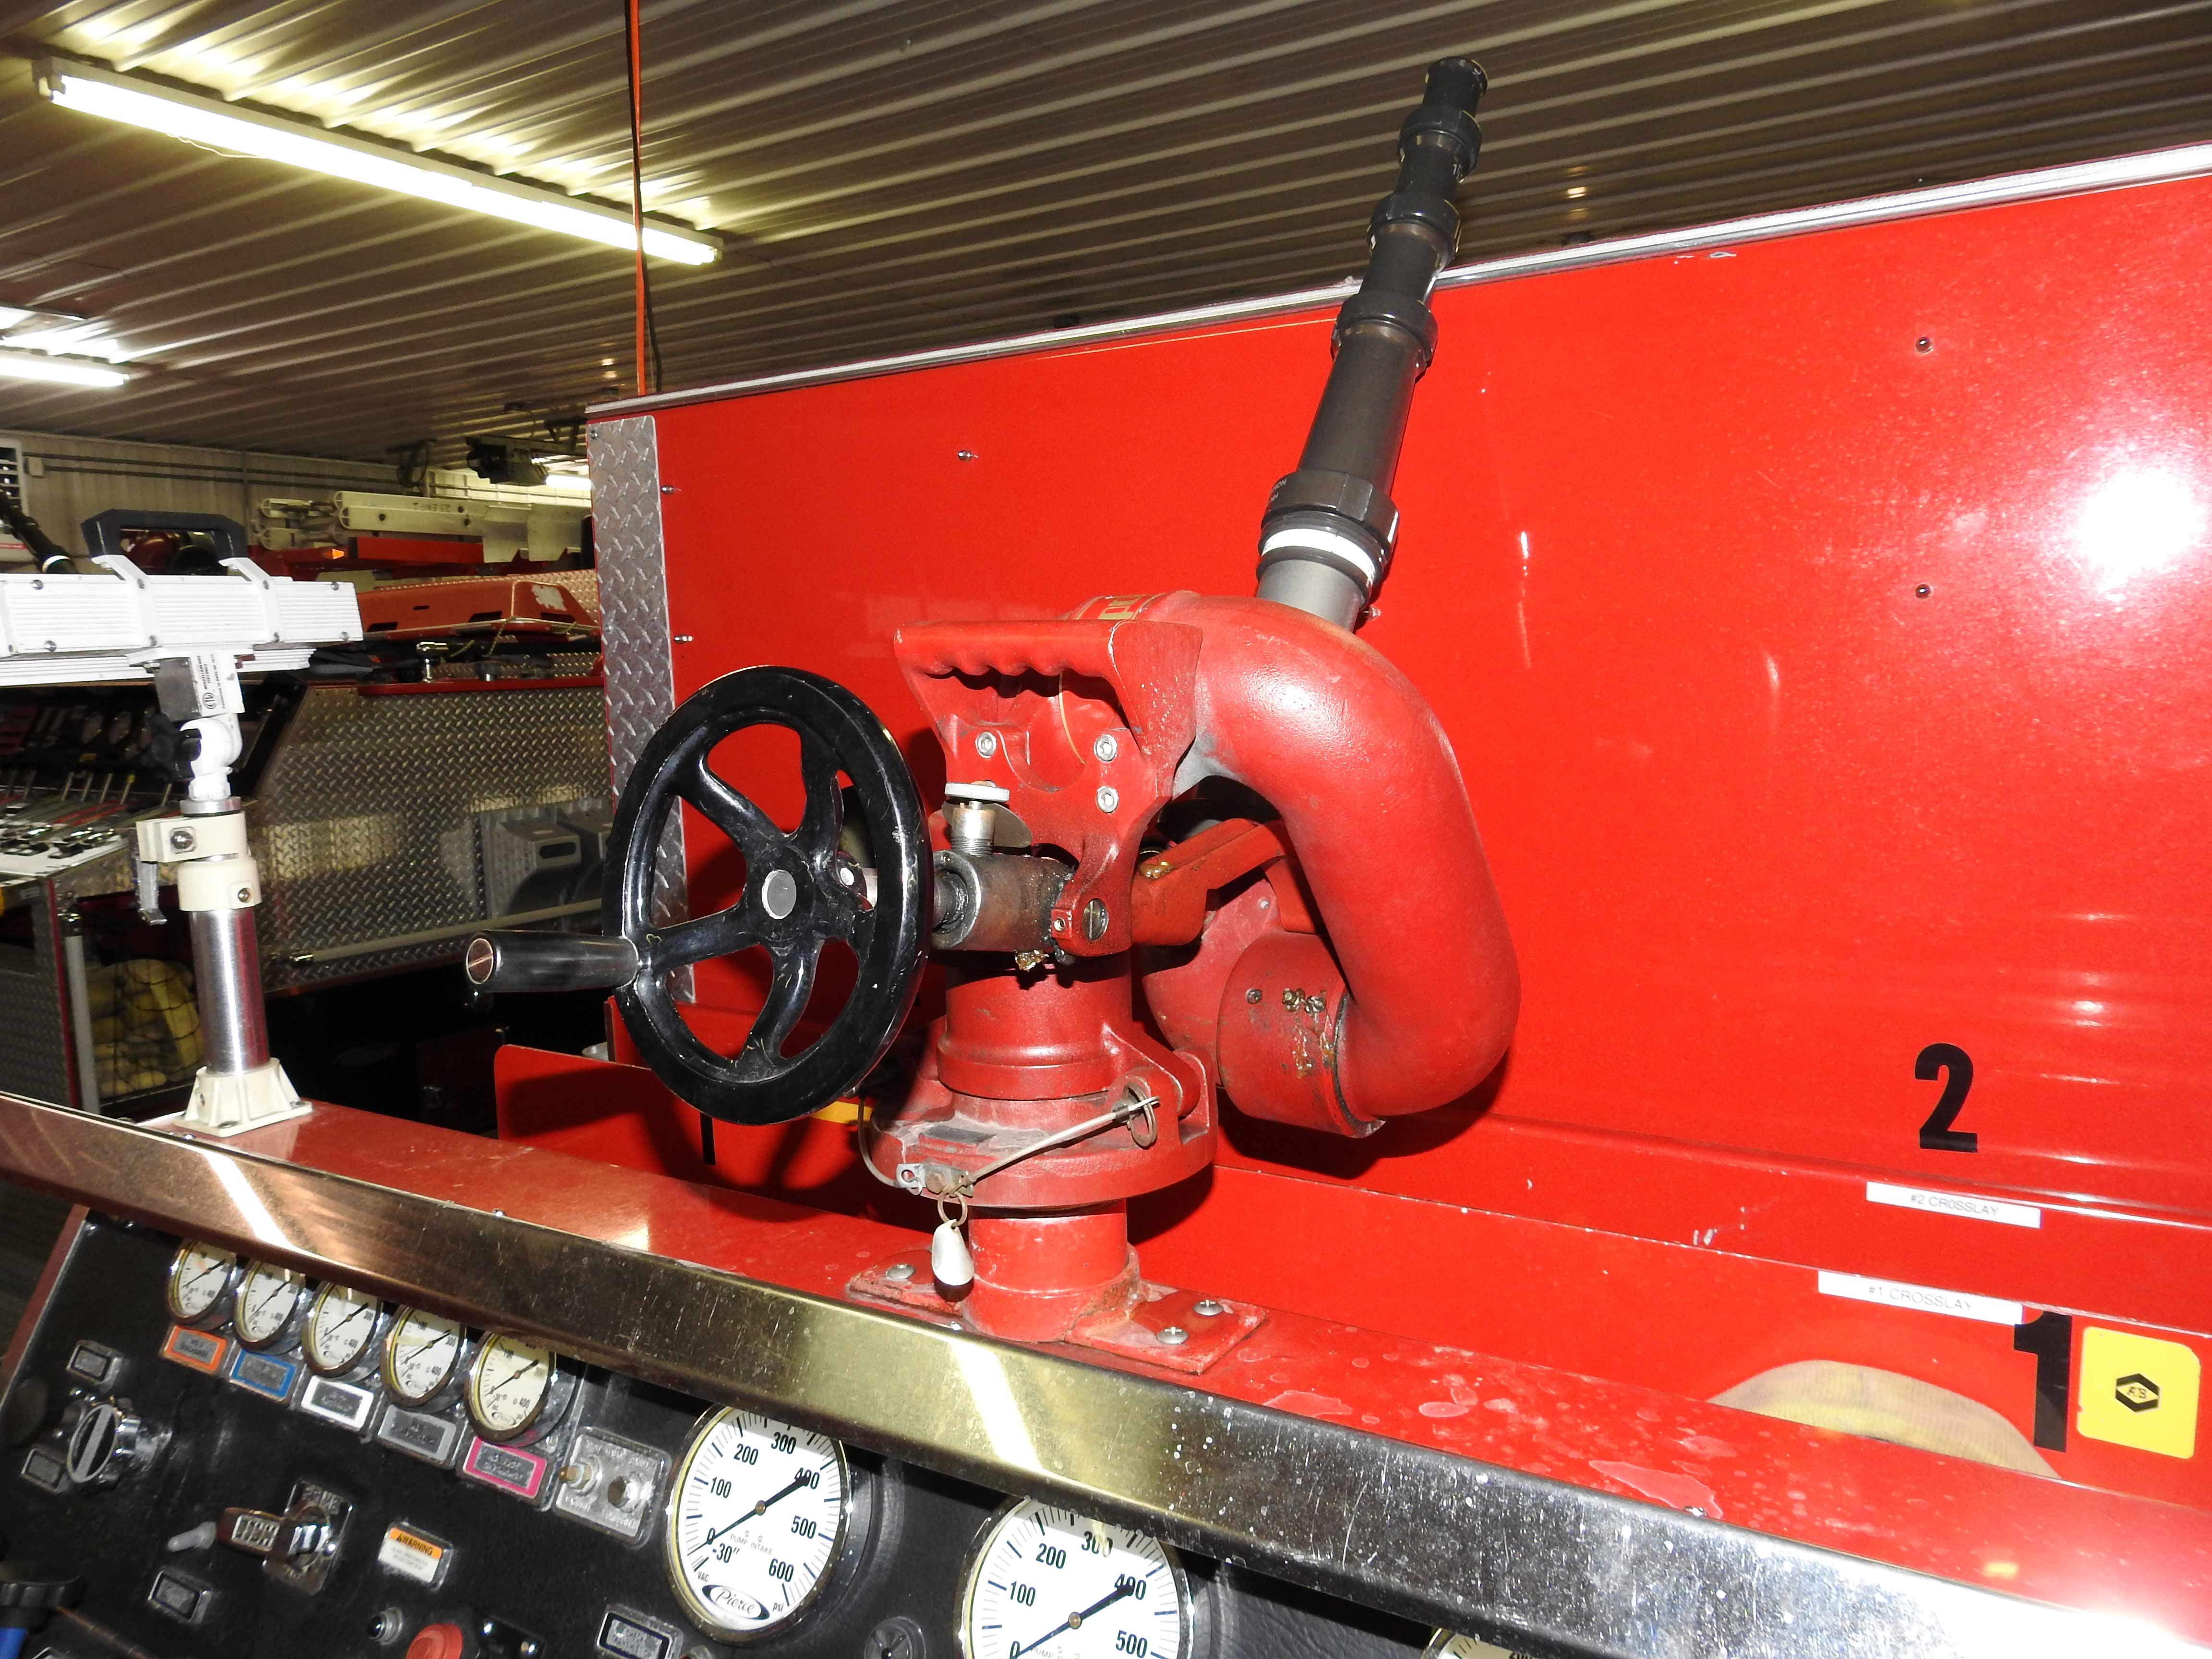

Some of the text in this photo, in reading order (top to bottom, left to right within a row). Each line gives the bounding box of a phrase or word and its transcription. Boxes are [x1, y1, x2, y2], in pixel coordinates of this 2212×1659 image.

[1914, 1043, 1978, 1153] 2
[1911, 1194, 1998, 1215] #2 CROSSLAY
[1868, 1286, 1973, 1310] #1 CROSSLAY
[2014, 1311, 2073, 1453] 1
[519, 1397, 530, 1409] 400
[733, 1443, 759, 1466] 200
[770, 1431, 797, 1455] 300
[710, 1476, 732, 1498] 100
[793, 1467, 820, 1490] 400
[707, 1527, 716, 1545] 0
[791, 1515, 817, 1539] 500
[402, 1534, 433, 1556] WARNING
[730, 1533, 773, 1555] PUMP INTAKE
[1035, 1542, 1067, 1569] 200
[1081, 1530, 1113, 1558] 300
[698, 1571, 709, 1583] VAC
[769, 1558, 794, 1583] 600
[1010, 1580, 1036, 1607] 100
[1114, 1573, 1147, 1600] 400
[715, 1588, 755, 1614] Pierce
[772, 1602, 785, 1612] psi
[1115, 1629, 1148, 1659] 500
